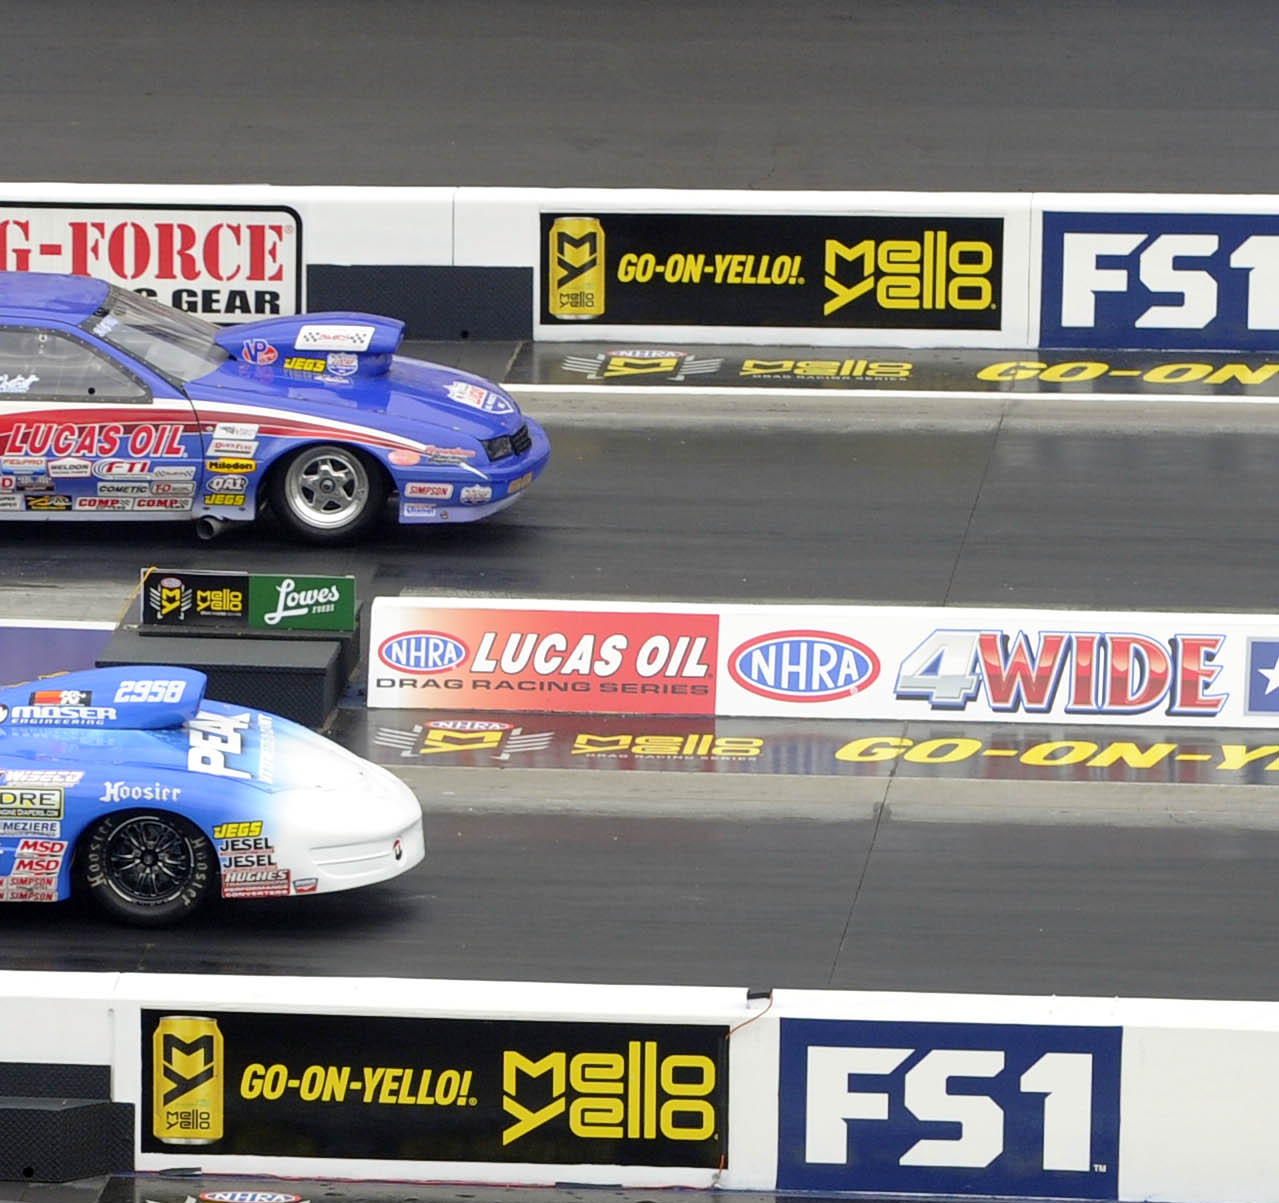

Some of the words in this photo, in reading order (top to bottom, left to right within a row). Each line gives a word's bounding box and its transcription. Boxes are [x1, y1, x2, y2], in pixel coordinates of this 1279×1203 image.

[618, 254, 799, 285] GO-ON-YELLO!
[1061, 232, 1279, 330] FS1
[172, 288, 281, 315] GEAR
[284, 358, 326, 372] JEGS
[5, 423, 123, 457] LUCAS
[129, 424, 185, 457] OIL
[208, 461, 253, 470] Milodon
[212, 476, 245, 490] QA1
[409, 486, 448, 496] SIMPSON
[204, 494, 245, 505] JEGS
[264, 578, 339, 625] Lowes
[390, 634, 458, 669] NHRA
[470, 632, 628, 677] LUCAS
[636, 635, 708, 678] OIL
[750, 640, 860, 692] NHRA
[113, 680, 187, 703] 2958
[376, 678, 463, 690] DRAG
[472, 679, 591, 693] RACING
[600, 682, 709, 695] SERIES
[11, 706, 117, 720] MOSER
[11, 718, 105, 726] ENGINEERING
[187, 711, 252, 780] PEAK
[834, 737, 1279, 770] GO-ON-Y
[100, 781, 181, 802] Hoosier
[0, 792, 56, 806] DRE
[3, 822, 56, 831] MEZIERE
[214, 821, 262, 838] JEGS
[20, 840, 64, 853] MSD
[220, 838, 274, 851] JESEL
[16, 859, 59, 871] MSD
[224, 855, 276, 868] JESEL
[10, 878, 52, 886] SIMPSON
[225, 871, 287, 882] HUGHES
[10, 892, 52, 900] SIMPSON
[240, 1063, 471, 1107] GO-ON-YELLO!
[805, 1045, 1093, 1172] FS1
[213, 1192, 287, 1202] NHRA
